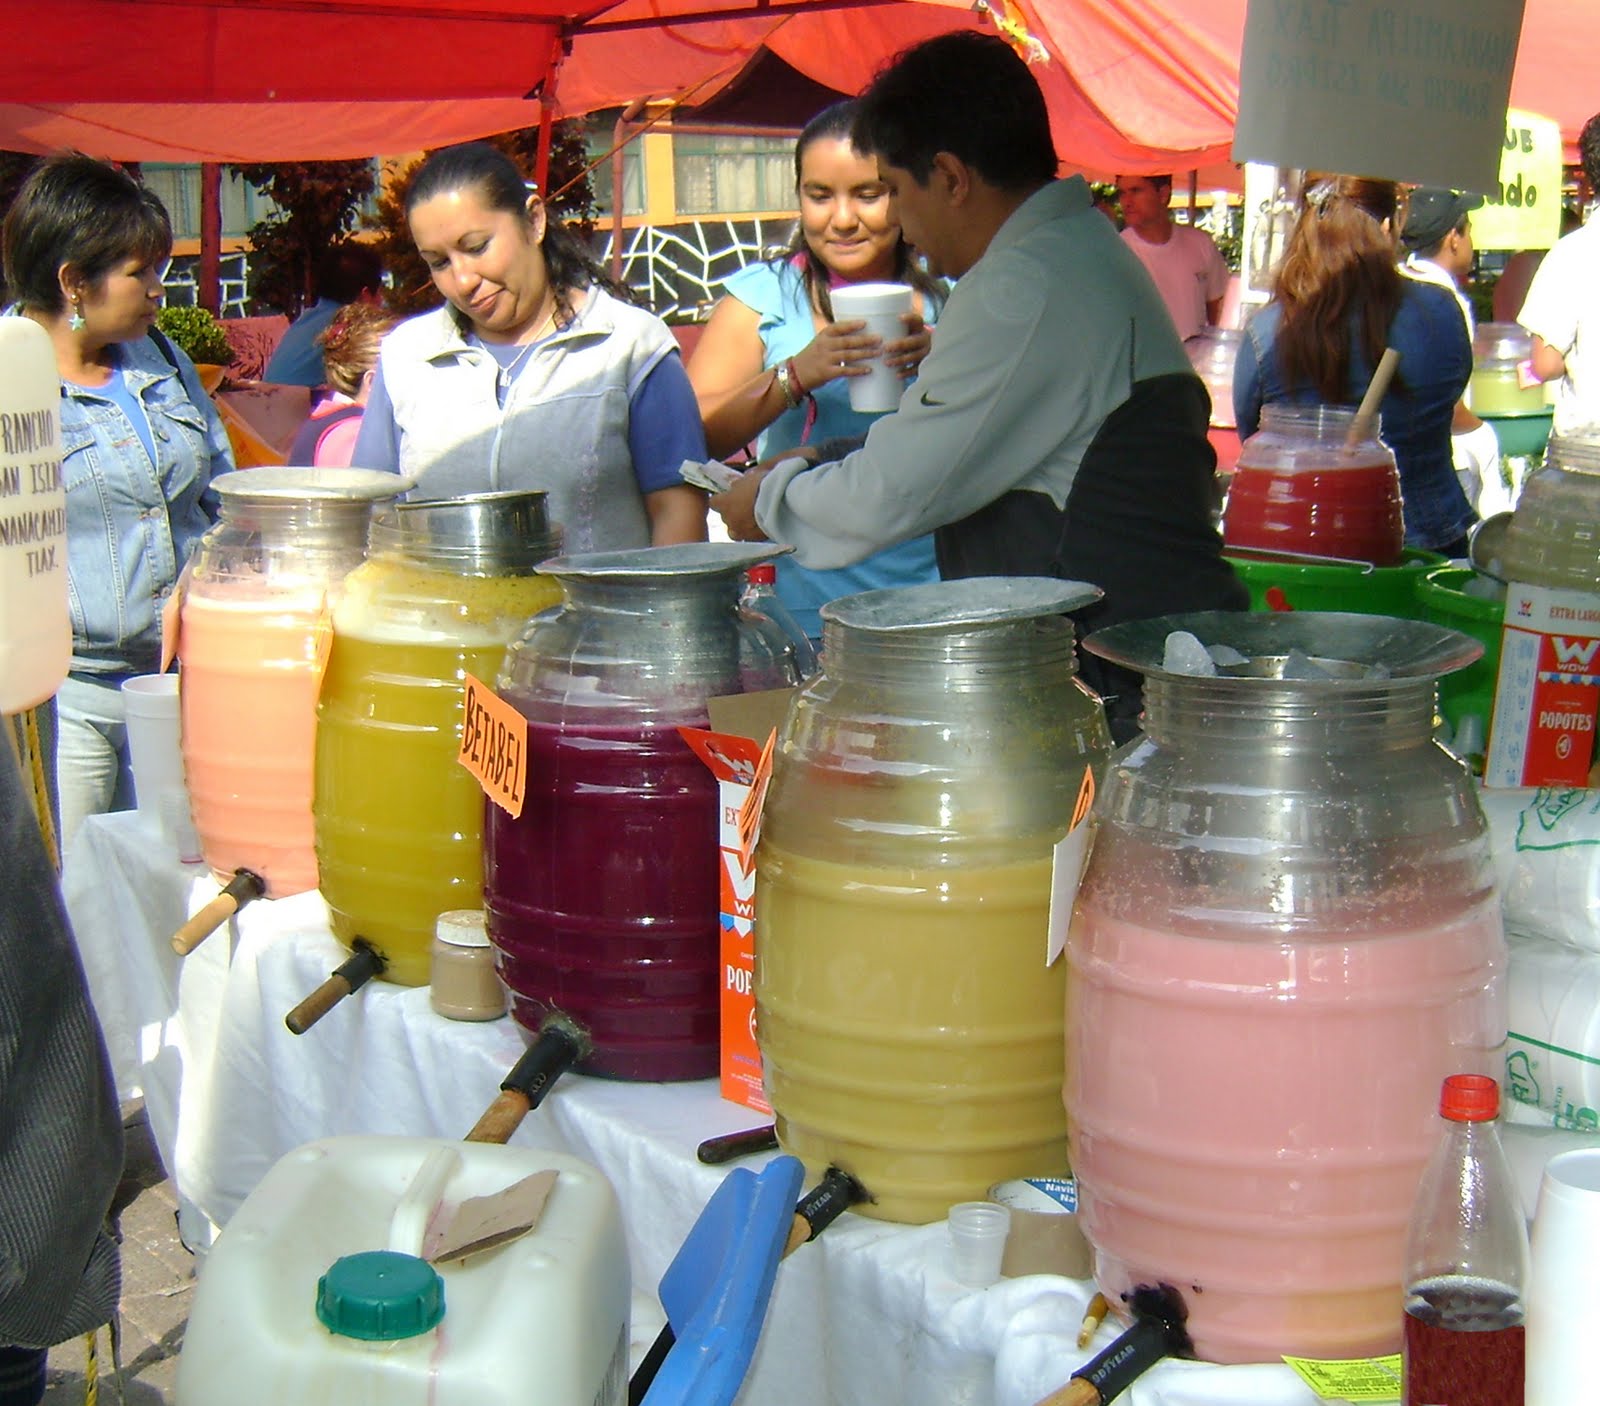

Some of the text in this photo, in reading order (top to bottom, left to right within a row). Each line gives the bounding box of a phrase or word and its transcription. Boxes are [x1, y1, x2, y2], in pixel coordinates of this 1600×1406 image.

[1, 408, 54, 455] RANCHO
[0, 465, 20, 498] AN
[1556, 663, 1590, 672] WOW
[1539, 711, 1593, 731] POPOTES
[462, 685, 521, 803] BETABEL
